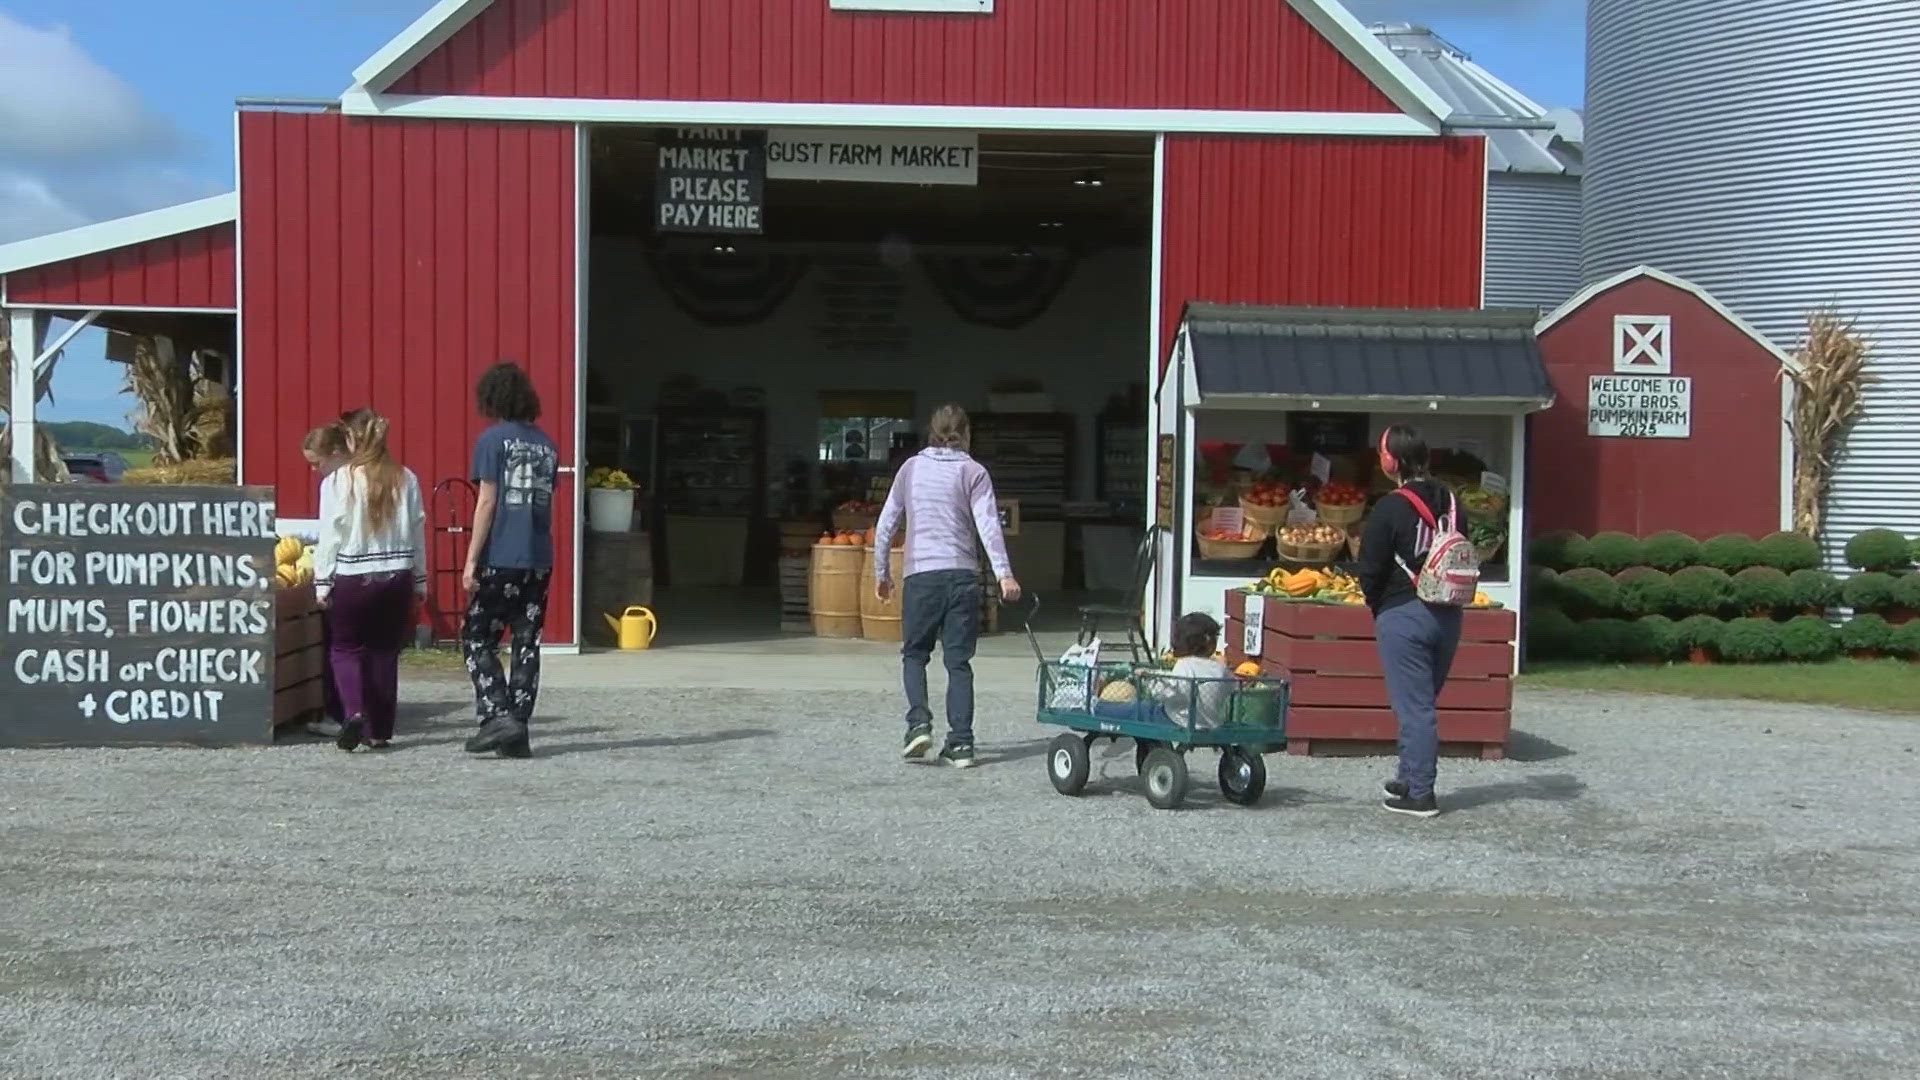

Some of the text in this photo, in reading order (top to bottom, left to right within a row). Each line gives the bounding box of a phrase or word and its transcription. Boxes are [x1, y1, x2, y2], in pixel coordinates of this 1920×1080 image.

[659, 146, 749, 172] MARKET
[767, 141, 974, 169] GUST FARM MARKET
[670, 177, 751, 202] PLEASE
[661, 203, 760, 229] PAY HERE
[1591, 378, 1686, 394] WELCOME TO
[1590, 408, 1687, 425] PUMPKIN FARM
[1620, 423, 1657, 436] 2025
[203, 501, 276, 538] HERE
[9, 549, 269, 589] FOR PUMPKINS,
[8, 599, 115, 638] MUMS,
[14, 648, 262, 684] CASH or CHECK
[105, 689, 223, 724] CREDIT
